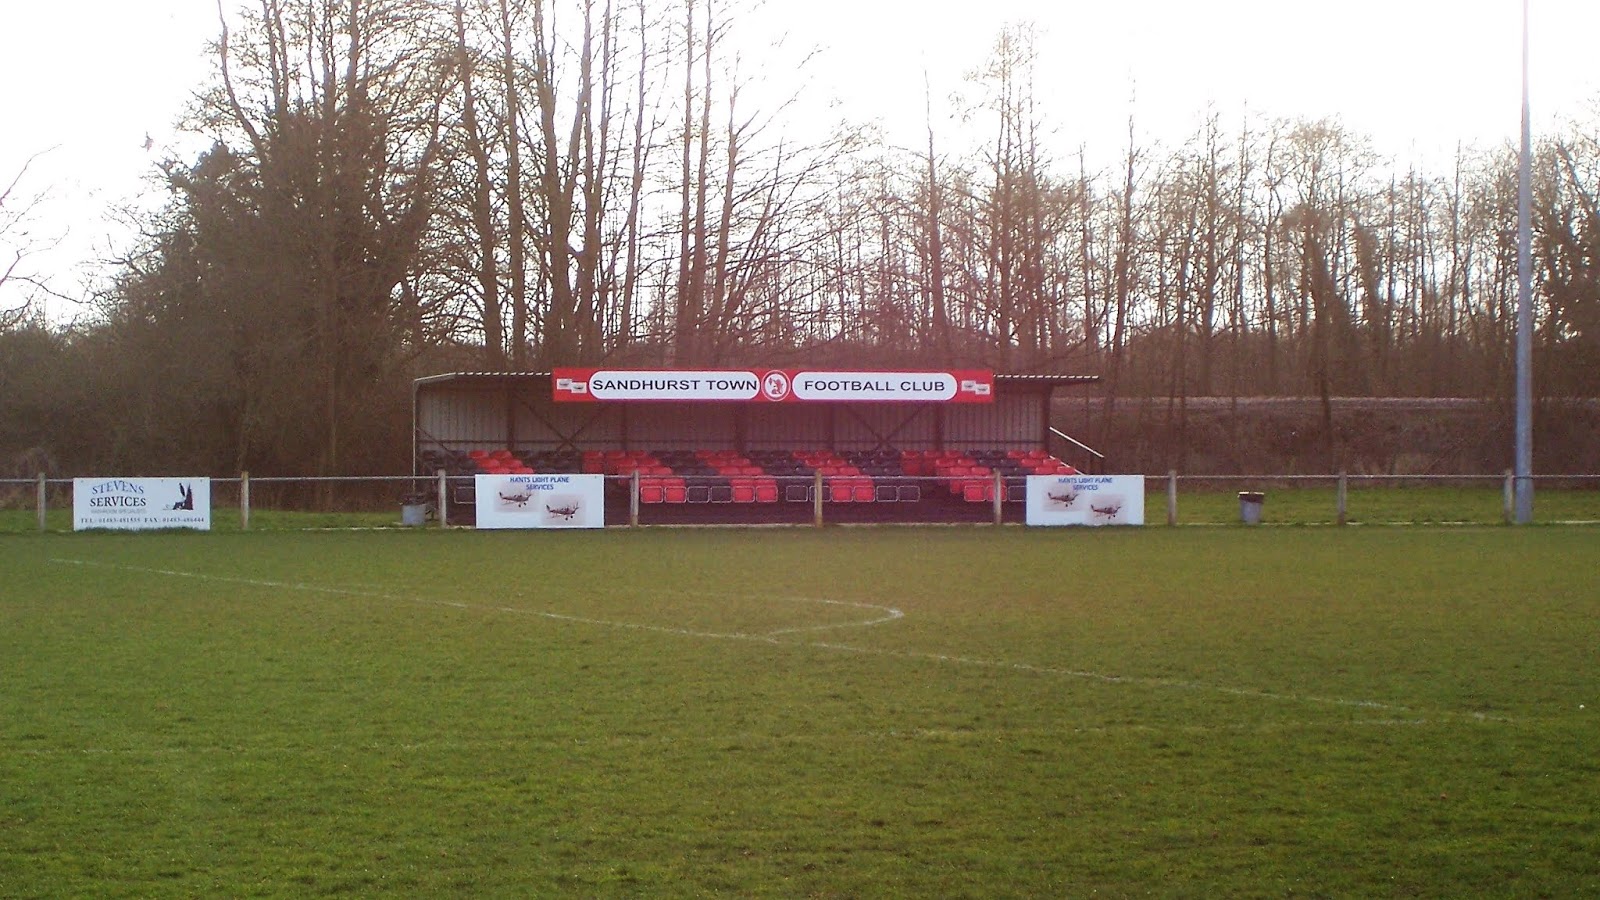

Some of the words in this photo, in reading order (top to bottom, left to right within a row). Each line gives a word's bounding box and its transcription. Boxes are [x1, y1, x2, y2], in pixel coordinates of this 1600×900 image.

[592, 379, 700, 391] SANDHURST
[705, 379, 757, 391] TOWN
[803, 380, 895, 391] FOOTBALL
[900, 380, 945, 391] CLUB
[92, 480, 145, 495] STEVENS
[90, 496, 146, 507] SERVICES
